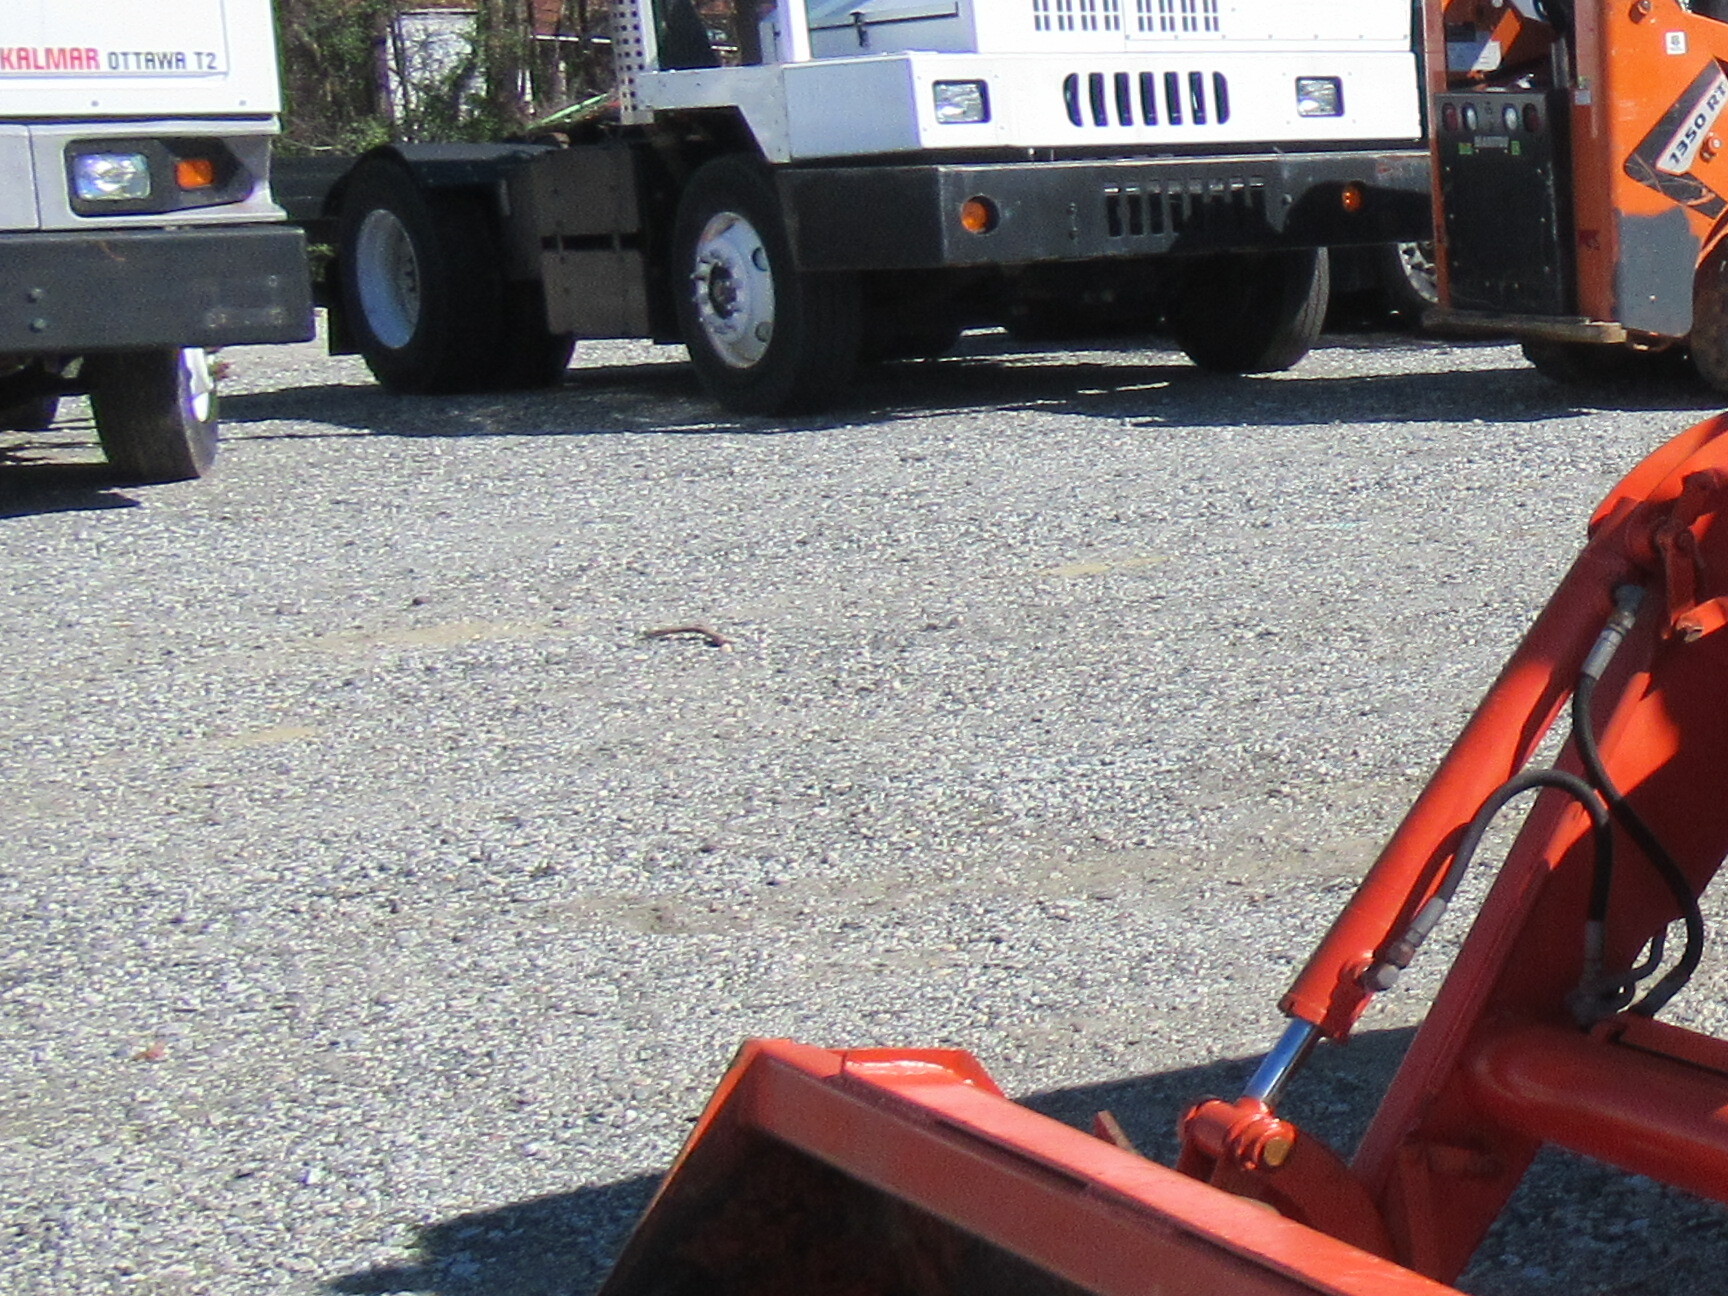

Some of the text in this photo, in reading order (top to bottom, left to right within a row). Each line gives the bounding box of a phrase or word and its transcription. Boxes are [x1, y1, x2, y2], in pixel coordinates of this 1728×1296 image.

[0, 47, 218, 71] KALMAR OTTAWA T2
[1668, 81, 1728, 165] 1350 RT
